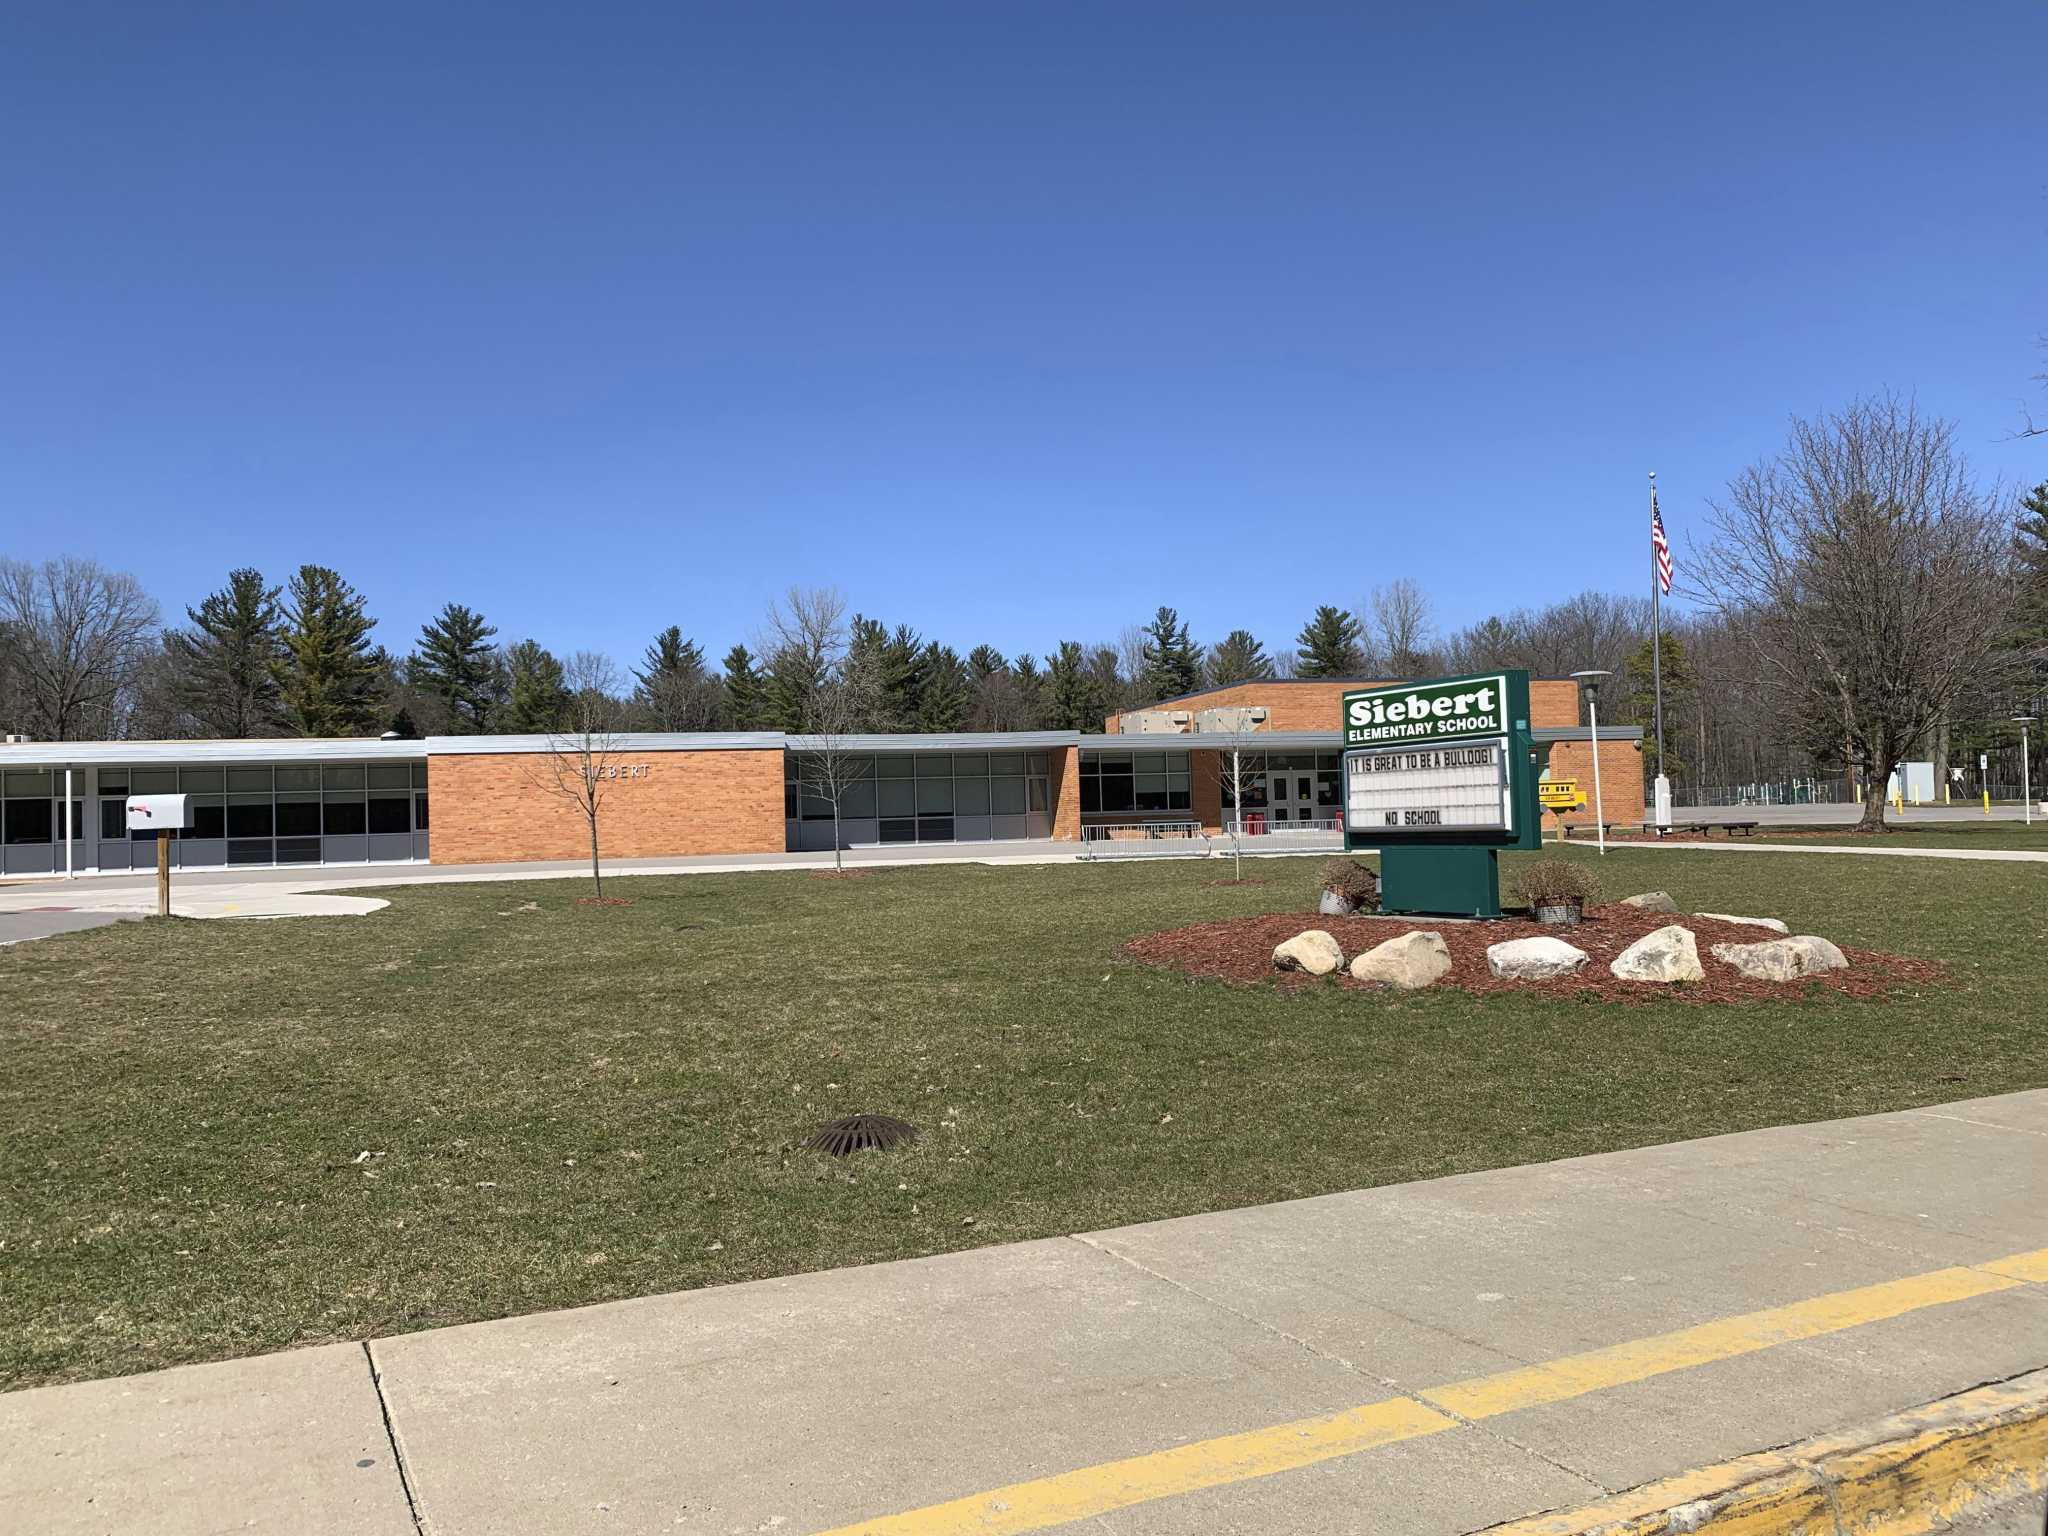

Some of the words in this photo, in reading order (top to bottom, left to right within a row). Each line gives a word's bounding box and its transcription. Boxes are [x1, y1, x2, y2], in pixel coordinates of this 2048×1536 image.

[1349, 687, 1495, 726] Siebert
[1349, 722, 1433, 741] ELEMENTARY
[1437, 715, 1497, 734] SCHOOL
[1350, 760, 1359, 772] IT
[1362, 758, 1372, 771] IS
[1374, 755, 1402, 771] GREAT
[1405, 754, 1417, 768] TO
[1420, 753, 1432, 768] BE
[1434, 753, 1440, 766] A
[1385, 811, 1398, 825] NO
[1404, 810, 1442, 825] SCHOOL
